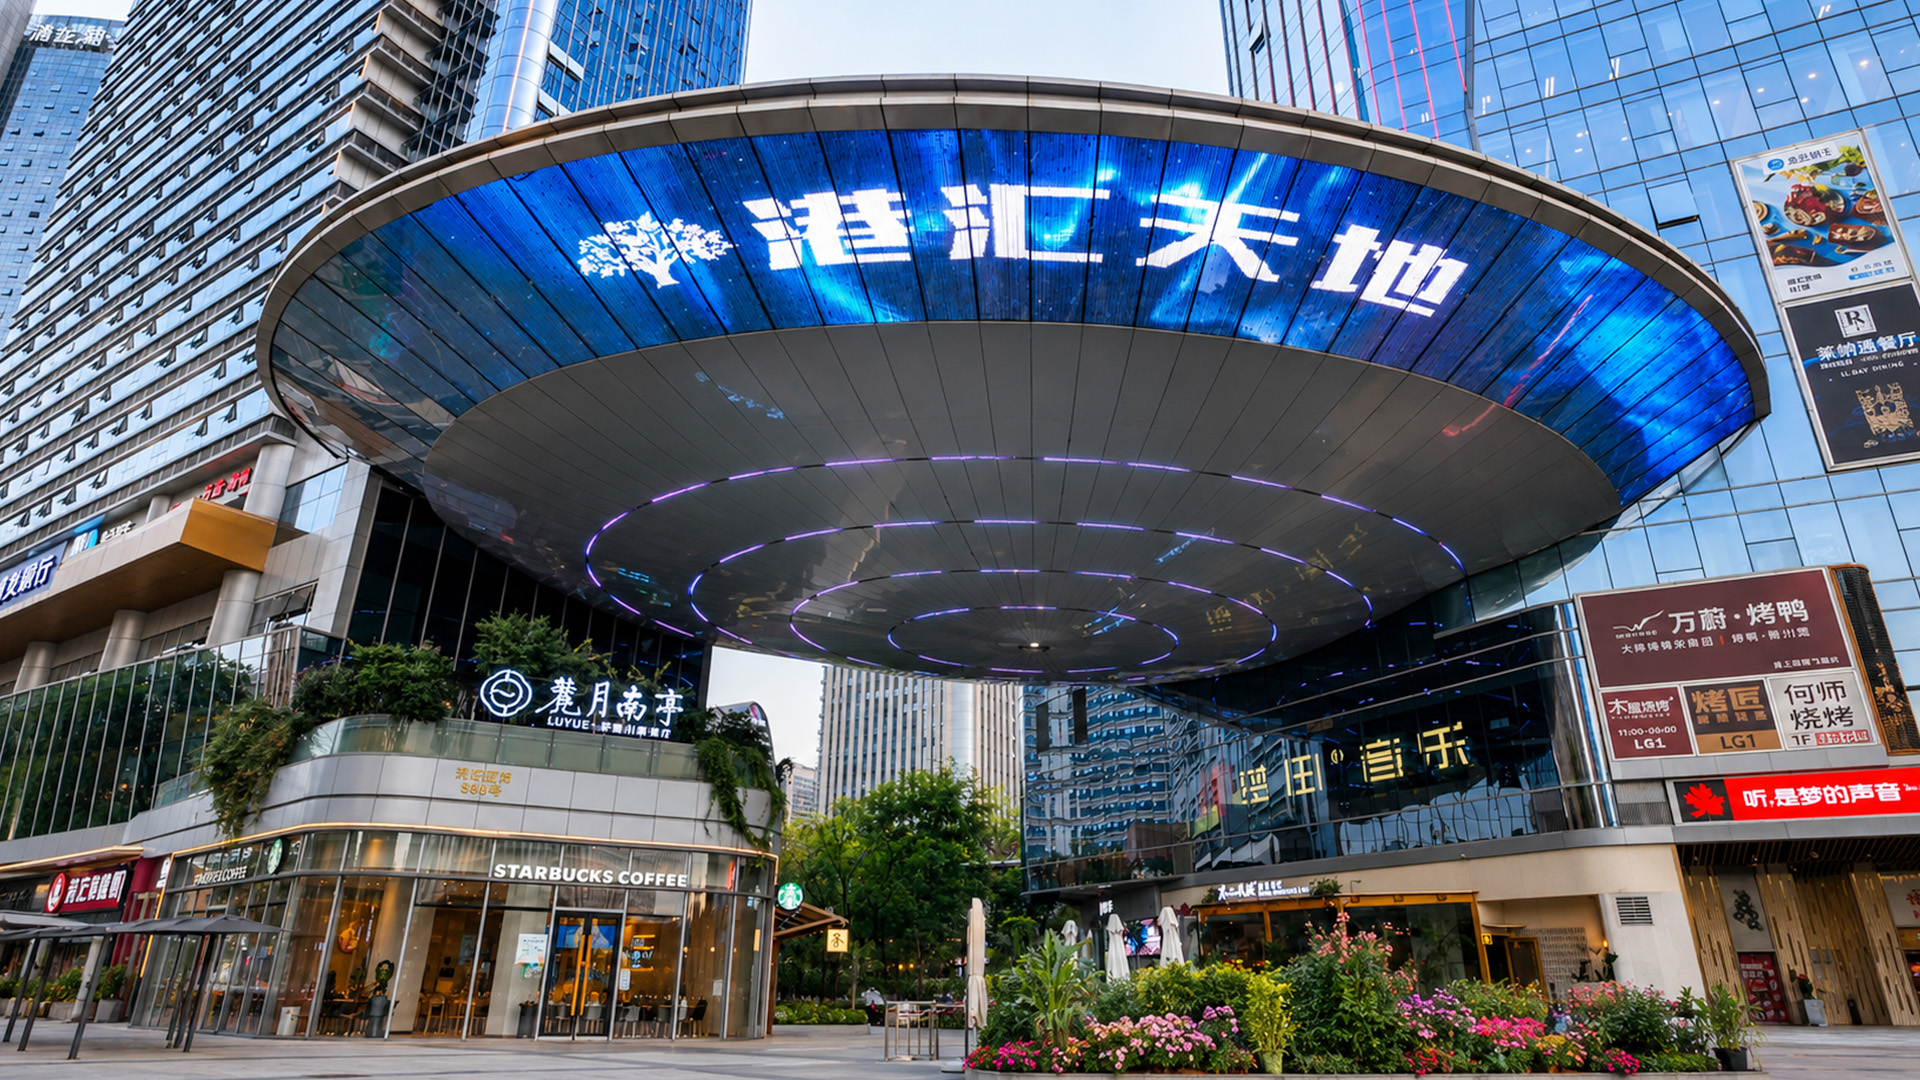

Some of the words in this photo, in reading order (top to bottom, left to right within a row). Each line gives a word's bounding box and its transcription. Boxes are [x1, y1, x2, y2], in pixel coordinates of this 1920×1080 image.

[742, 183, 1469, 318] 港汇天地
[1691, 686, 1765, 714] 烤匠
[1784, 680, 1847, 705] 何师
[547, 715, 590, 730] LUYUE
[1790, 705, 1854, 730] 烧烤
[1634, 738, 1667, 750] LG1
[1720, 734, 1756, 749] LG1
[494, 864, 613, 884] STARBUCKS
[617, 871, 688, 887] COFFEE
